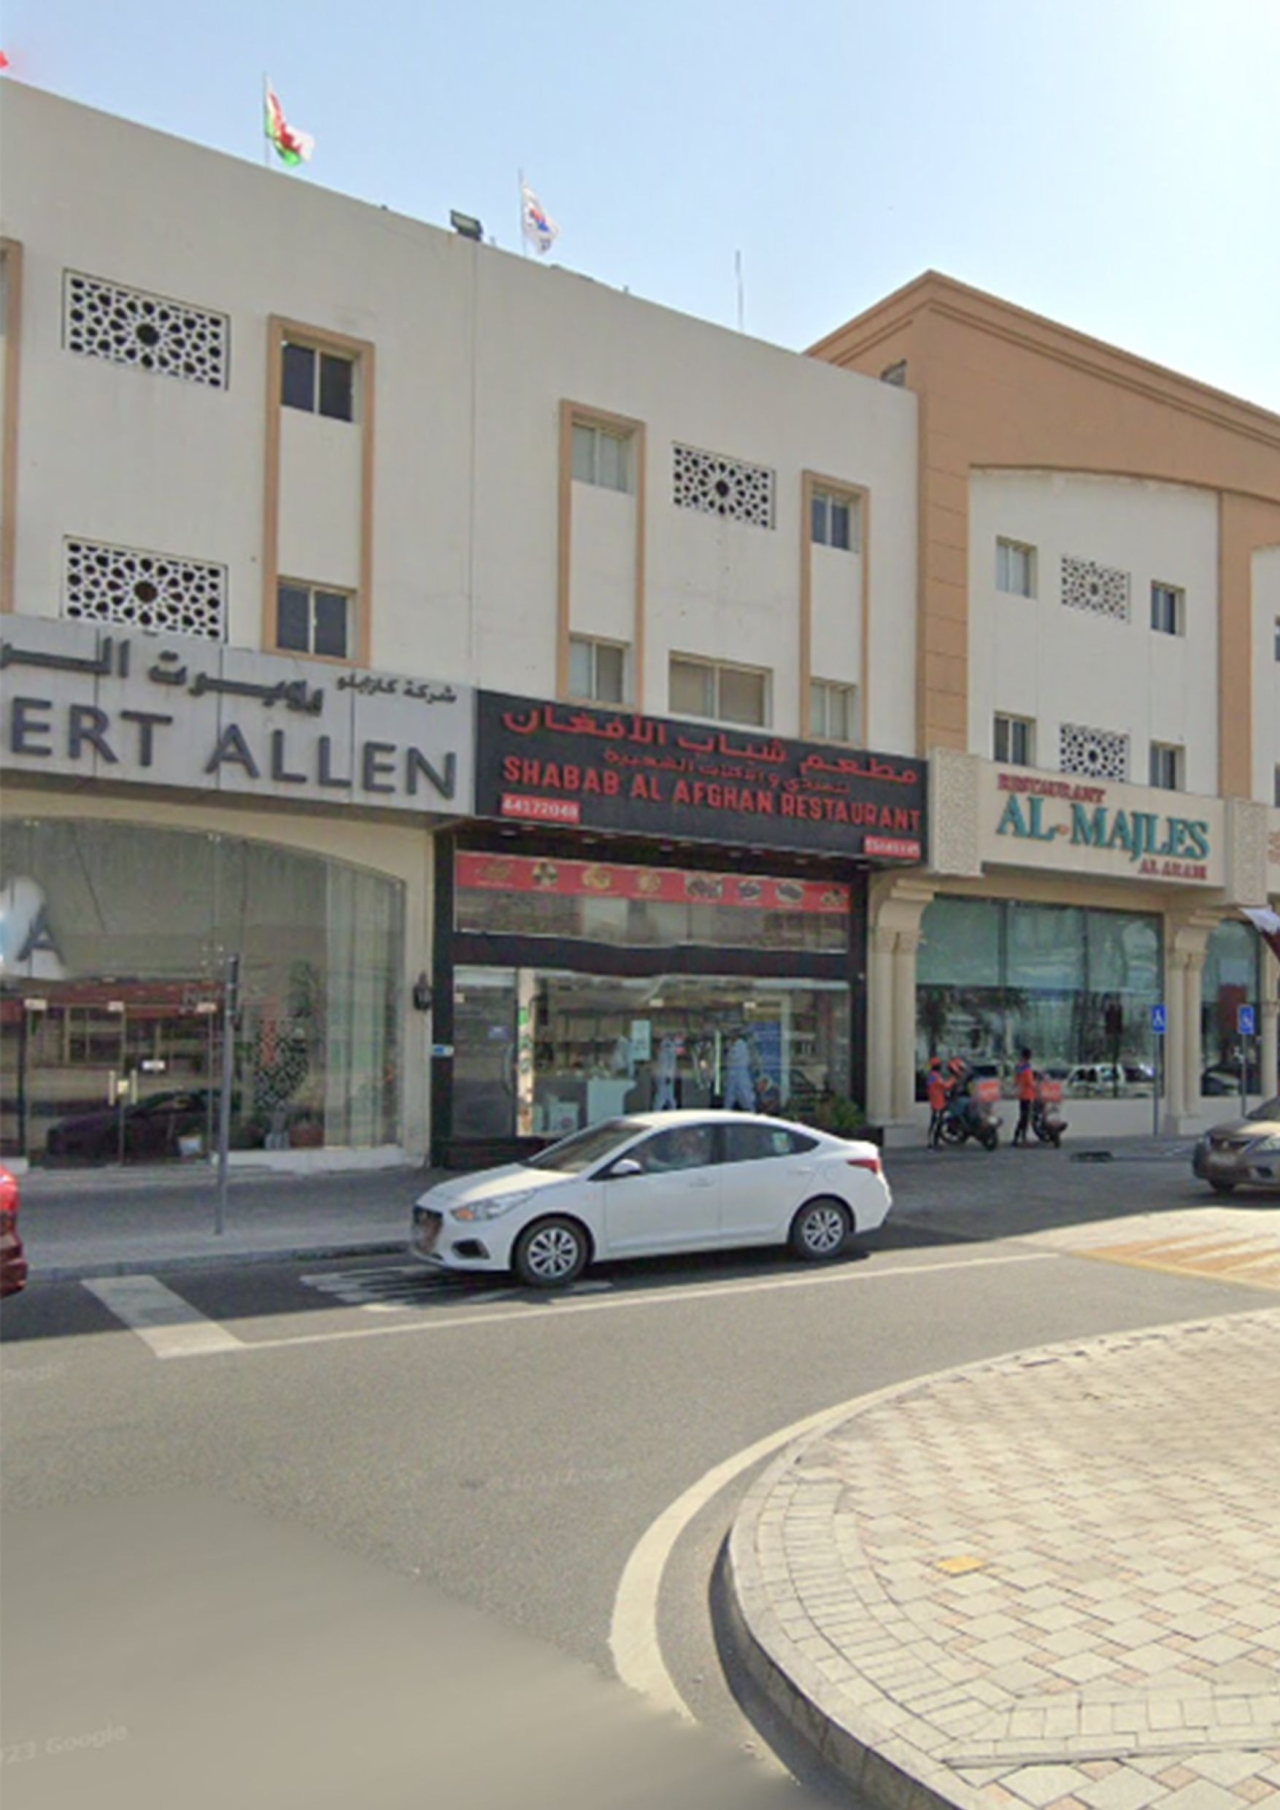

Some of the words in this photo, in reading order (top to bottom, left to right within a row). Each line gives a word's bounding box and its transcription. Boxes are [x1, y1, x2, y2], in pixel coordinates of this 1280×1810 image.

[402, 679, 457, 705] شركة
[205, 722, 457, 800] ALLEN
[677, 732, 788, 764] شباب
[800, 753, 918, 785] مطعم
[504, 755, 620, 796] SHABAB
[630, 771, 663, 801] AL
[673, 778, 775, 815] AFGHAN
[780, 794, 921, 832] RESTAURANT
[997, 772, 1106, 804] RESTAURANT
[1137, 857, 1160, 875] AL
